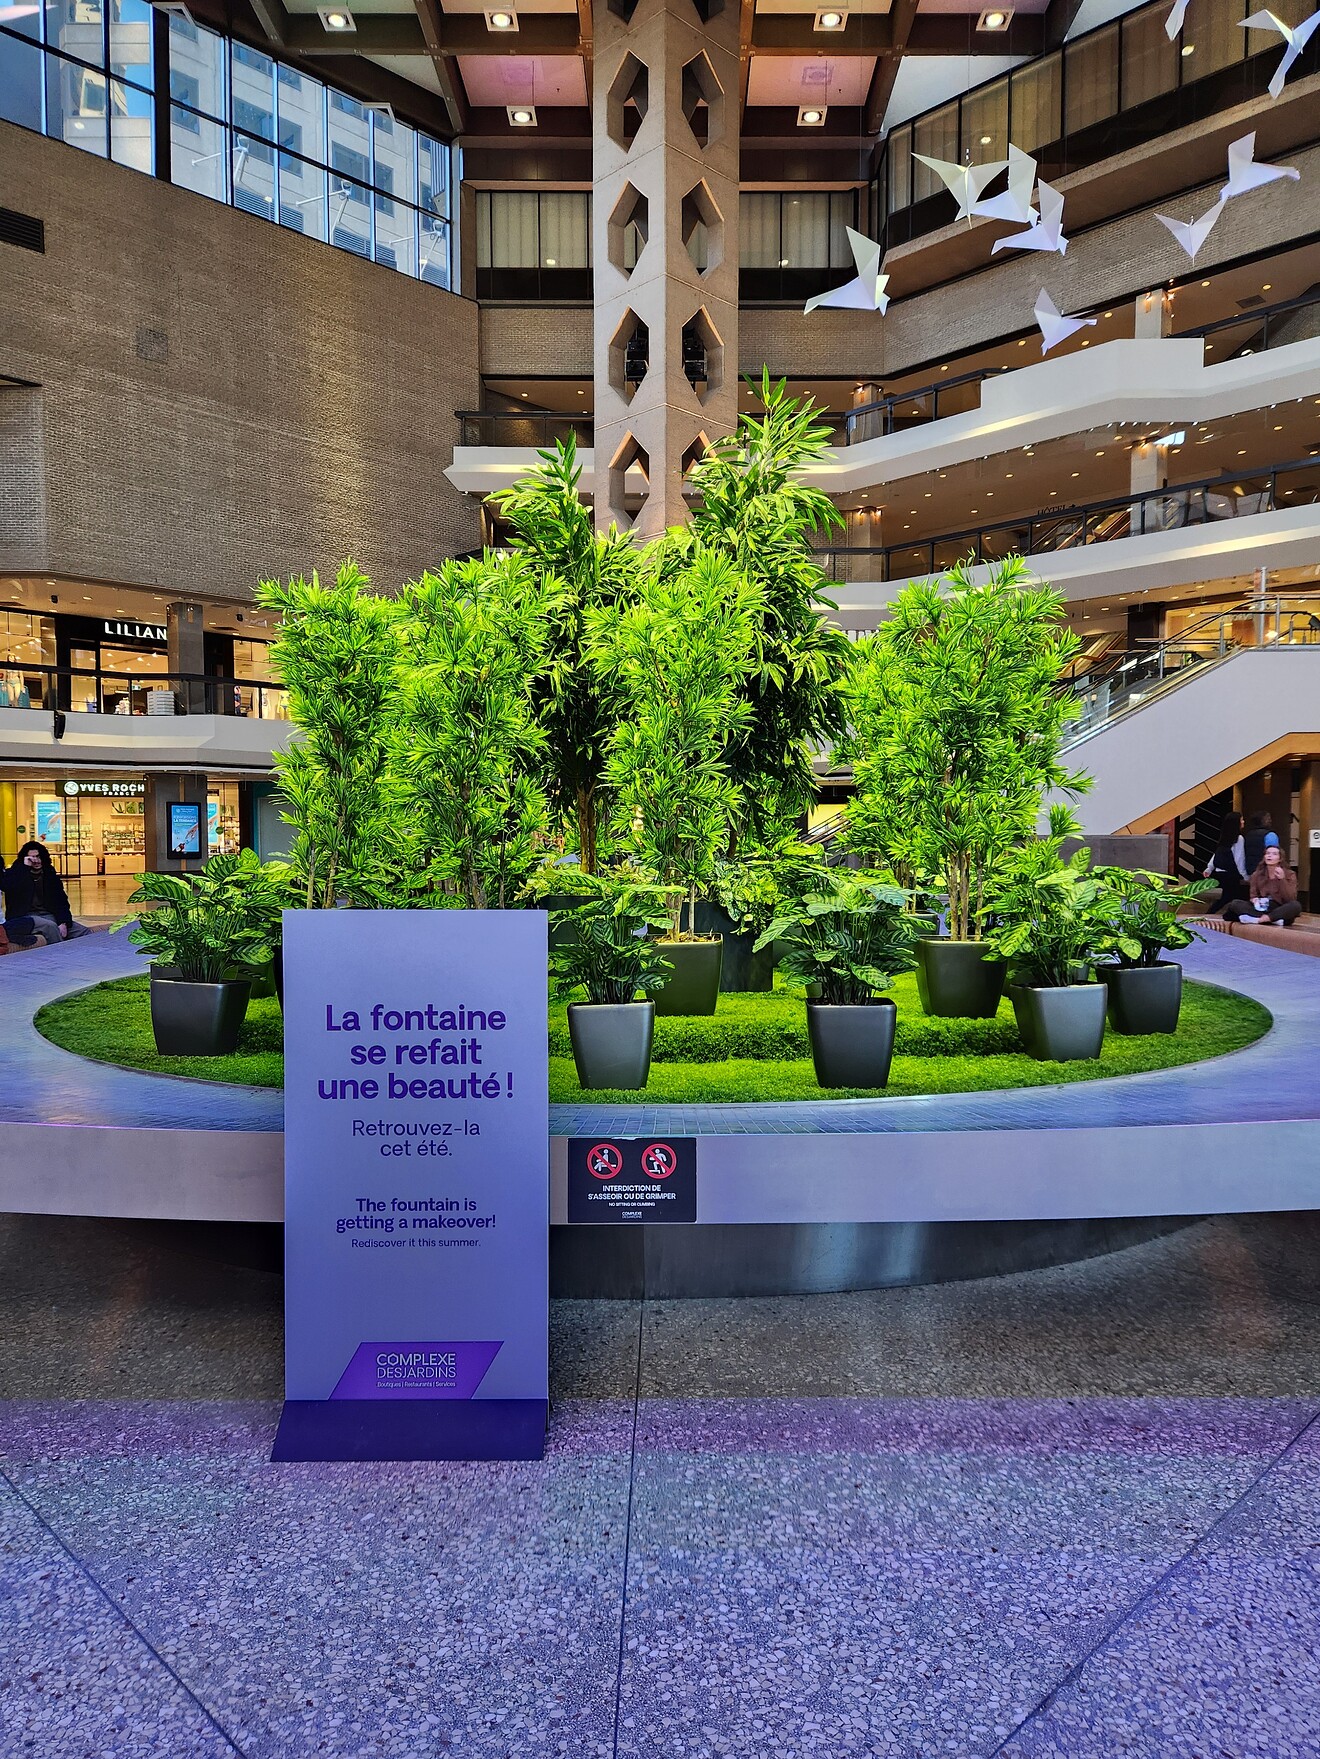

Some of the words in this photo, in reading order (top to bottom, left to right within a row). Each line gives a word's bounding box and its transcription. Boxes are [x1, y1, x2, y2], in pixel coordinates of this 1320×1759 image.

[79, 783, 110, 792] YVES
[326, 1004, 361, 1031] La
[370, 1004, 507, 1032] fontaine
[350, 1044, 387, 1066] se
[396, 1037, 482, 1066] refait
[317, 1079, 379, 1100] une
[352, 1119, 481, 1137] Retrouvez-la
[380, 1141, 412, 1157] cet
[417, 1139, 453, 1157] été.
[602, 1184, 651, 1192] INTERDICTION
[651, 1184, 662, 1192] DE
[587, 1192, 623, 1200] S'ASSEOIR
[623, 1192, 635, 1200] OU
[635, 1192, 645, 1200] DE
[645, 1192, 677, 1200] GRIMPER
[355, 1197, 387, 1212] The
[390, 1197, 460, 1212] fountain
[464, 1197, 477, 1212] is
[336, 1214, 395, 1234] getting
[399, 1217, 409, 1229] a
[412, 1214, 496, 1229] makeover!
[351, 1238, 406, 1248] Rediscover
[408, 1238, 416, 1248] it
[418, 1238, 437, 1248] this
[439, 1239, 481, 1248] summer.
[376, 1353, 456, 1366] COMPLEXE
[376, 1366, 456, 1379] DESJARDINS
